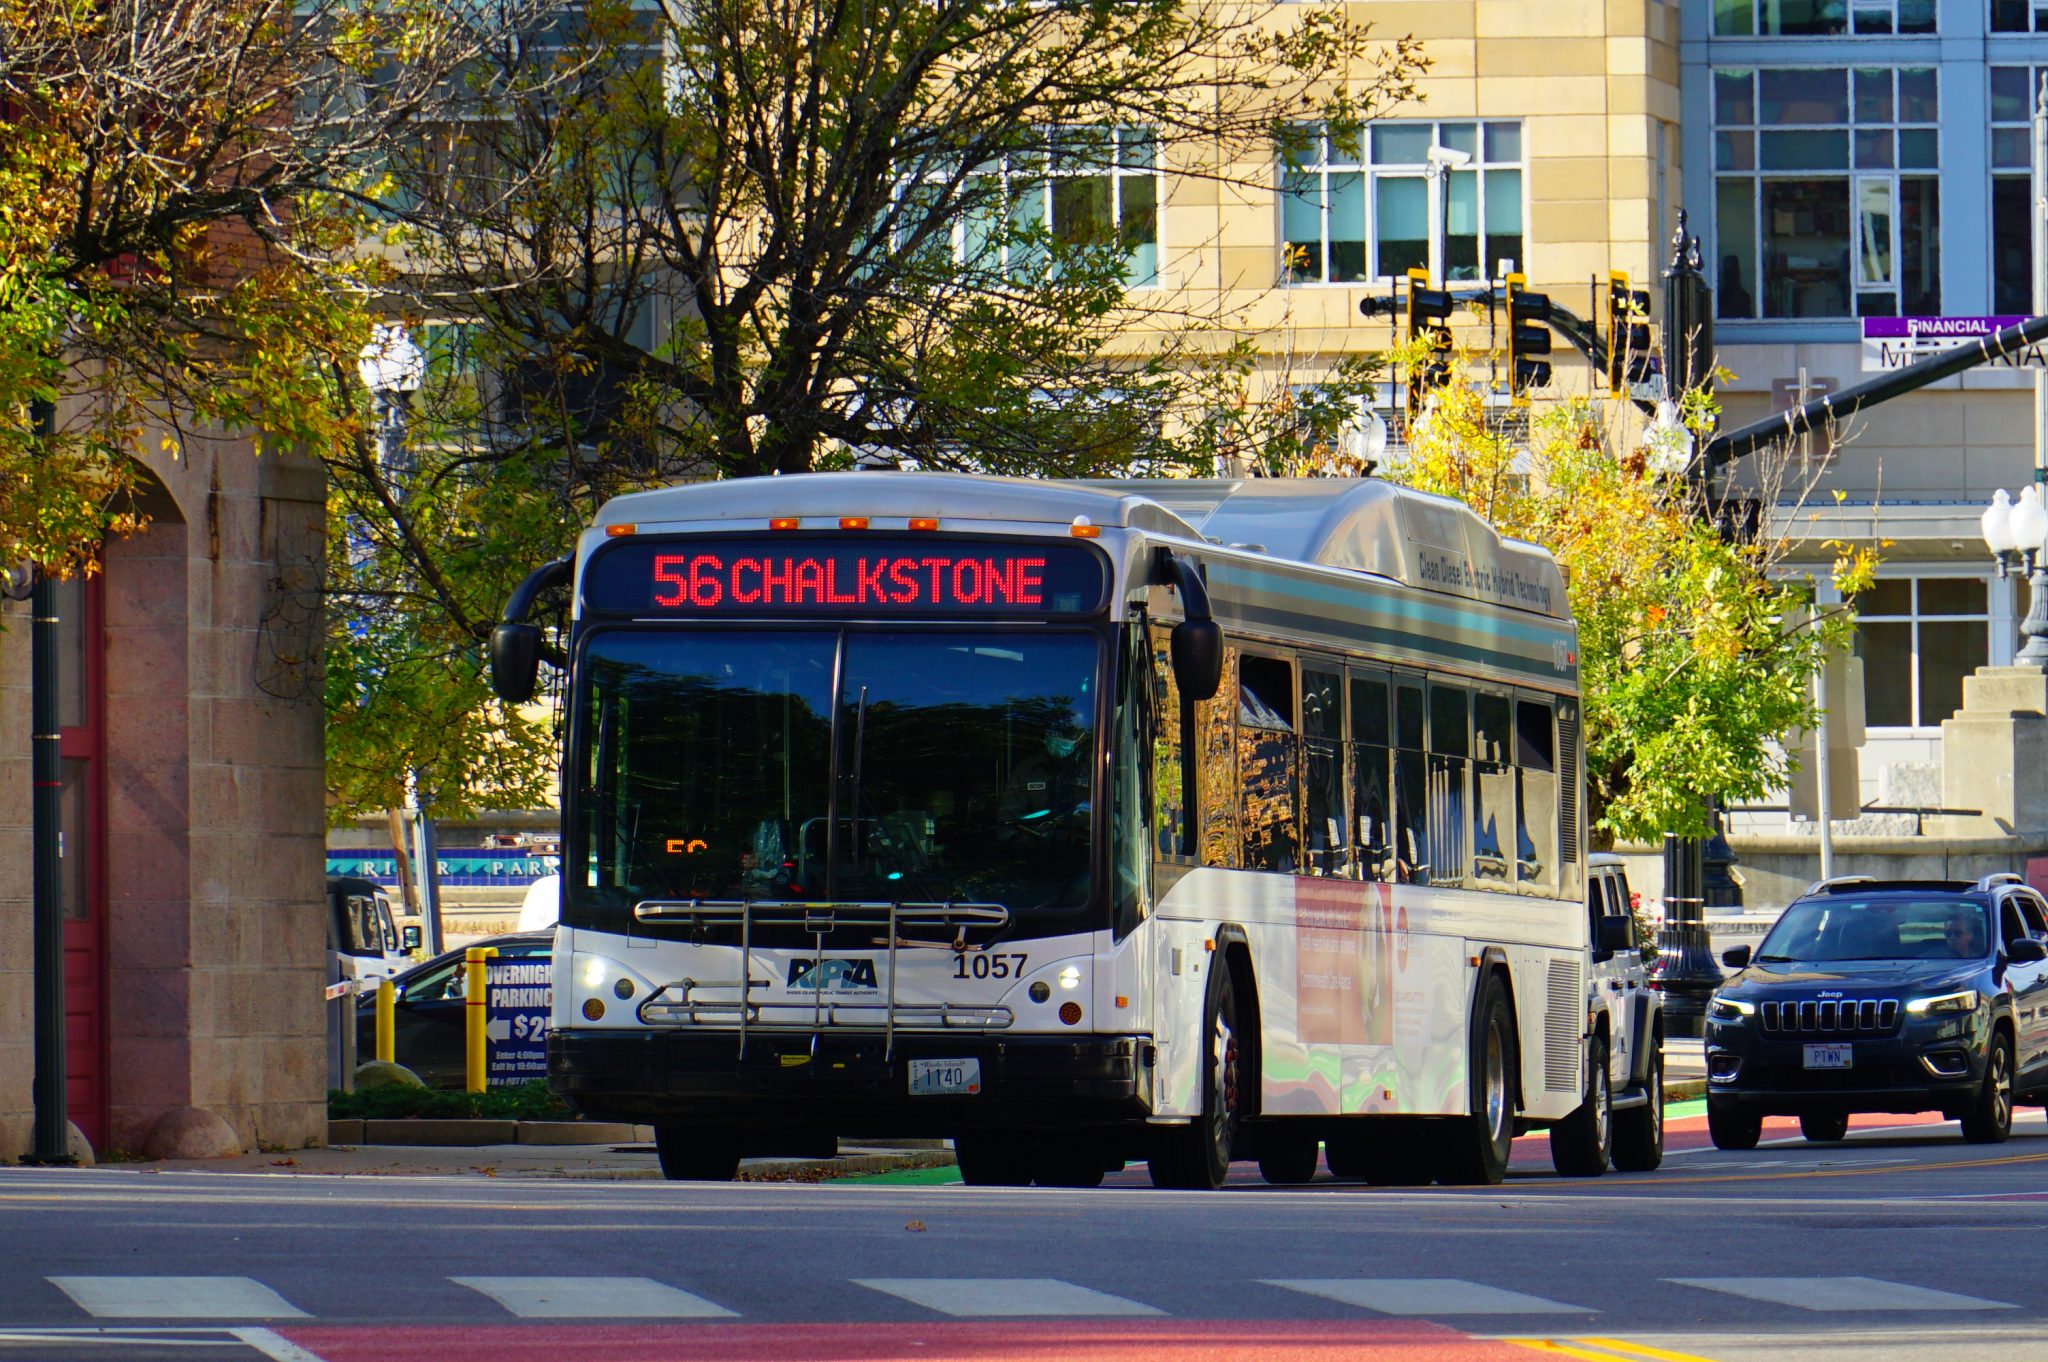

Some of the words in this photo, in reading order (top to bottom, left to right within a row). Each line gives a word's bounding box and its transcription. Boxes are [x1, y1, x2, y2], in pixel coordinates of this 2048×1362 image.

[1907, 319, 1990, 333] FINANCIAL
[654, 555, 722, 606] 56
[731, 557, 1046, 604] CHALKSTONE
[363, 861, 450, 878] RIR
[486, 965, 552, 985] OVERNIGH
[787, 958, 878, 988] RIPTA
[953, 953, 1028, 979] 1057
[496, 1051, 516, 1060] Enter
[926, 1068, 963, 1086] 1140
